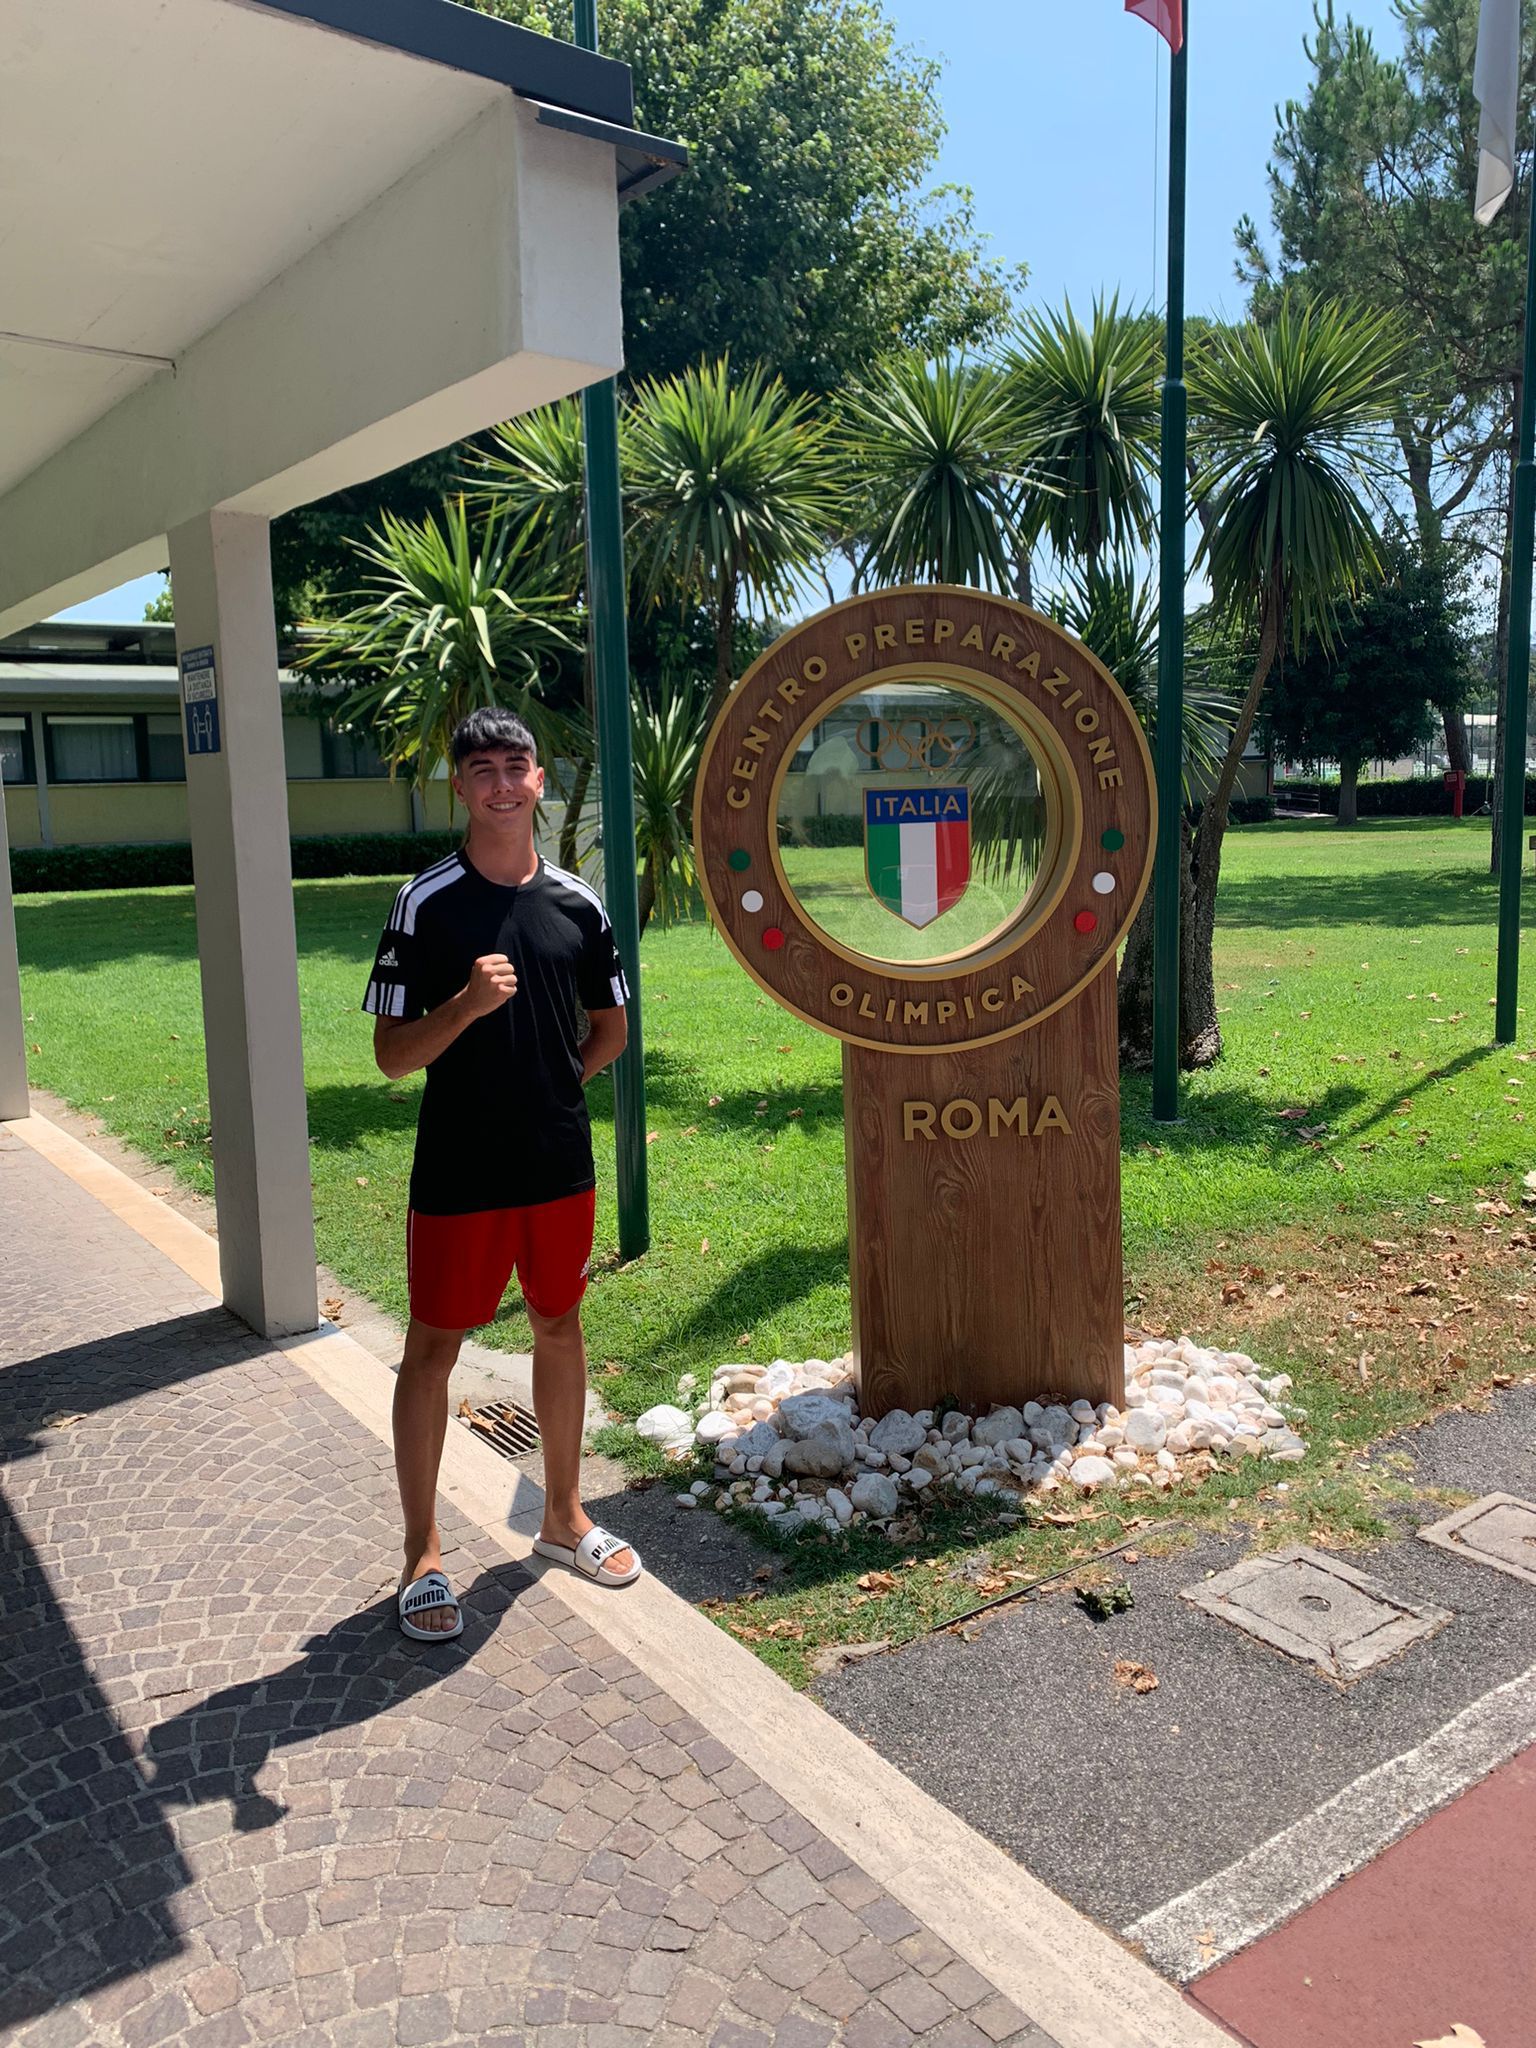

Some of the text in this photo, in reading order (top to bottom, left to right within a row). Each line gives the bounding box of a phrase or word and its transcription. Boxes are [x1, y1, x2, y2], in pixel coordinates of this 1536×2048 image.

[187, 670, 211, 682] MANTENERE
[726, 619, 1124, 809] CENTRO PREPARAZIONE
[875, 795, 961, 817] ITALIA
[830, 976, 1035, 1025] OLIMPICA
[903, 1096, 1072, 1141] ROMA
[404, 1589, 446, 1611] PUMA
